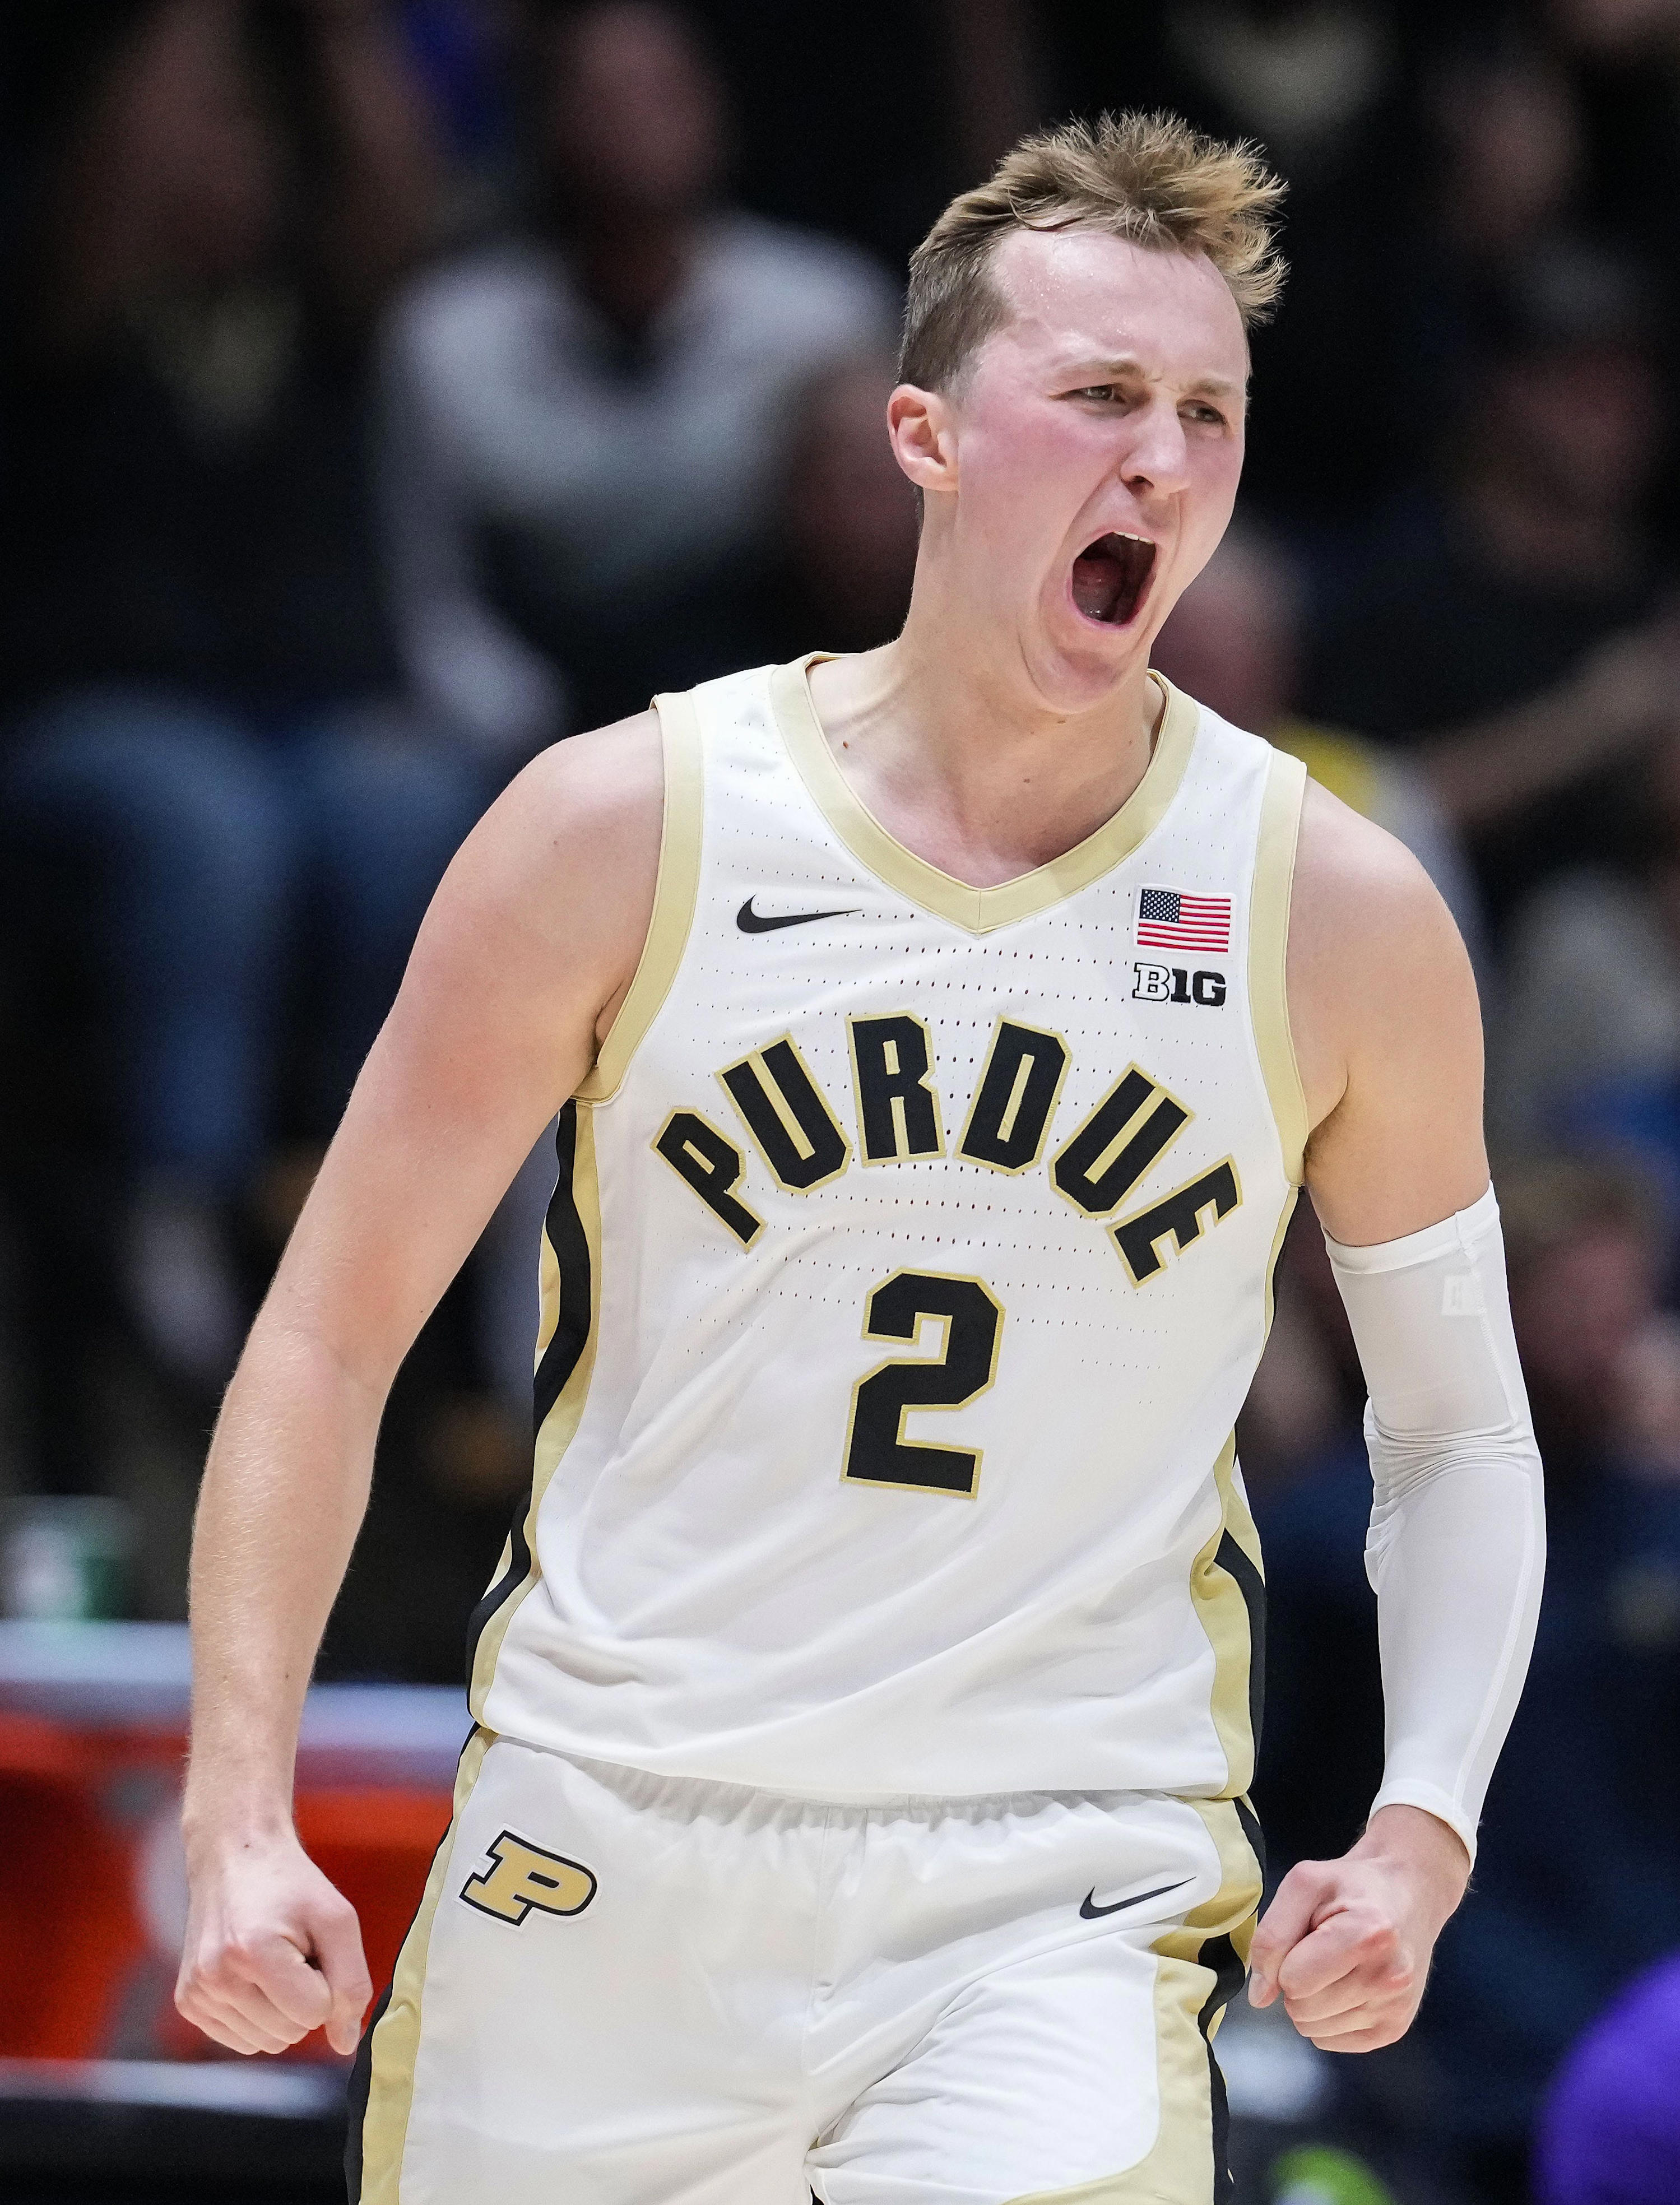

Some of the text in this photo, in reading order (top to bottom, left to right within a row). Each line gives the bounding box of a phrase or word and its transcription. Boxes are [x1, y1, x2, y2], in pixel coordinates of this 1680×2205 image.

[651, 1010, 1243, 1289] PURDUE
[839, 1267, 1006, 1500] 2
[458, 1829, 598, 1927] P
